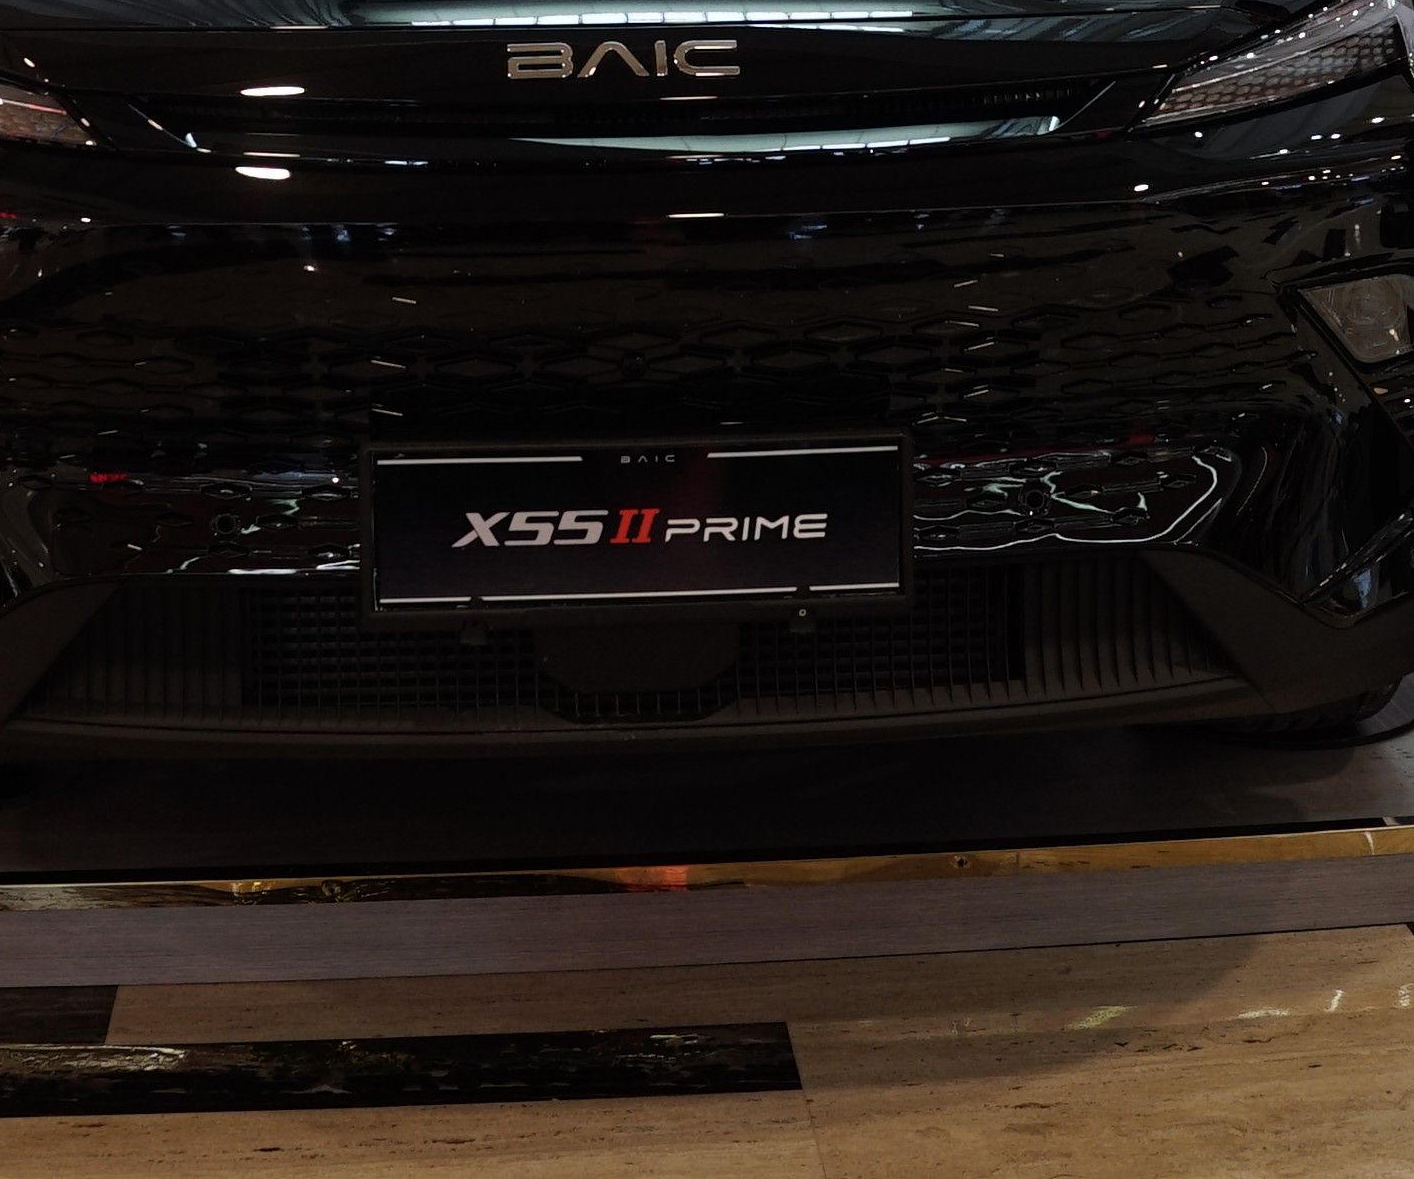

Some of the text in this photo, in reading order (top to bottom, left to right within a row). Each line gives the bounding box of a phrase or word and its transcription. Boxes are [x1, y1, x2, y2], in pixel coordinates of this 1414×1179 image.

[507, 40, 740, 78] BAIC
[620, 455, 676, 464] BAIC
[452, 508, 828, 548] X55 II PRIME
